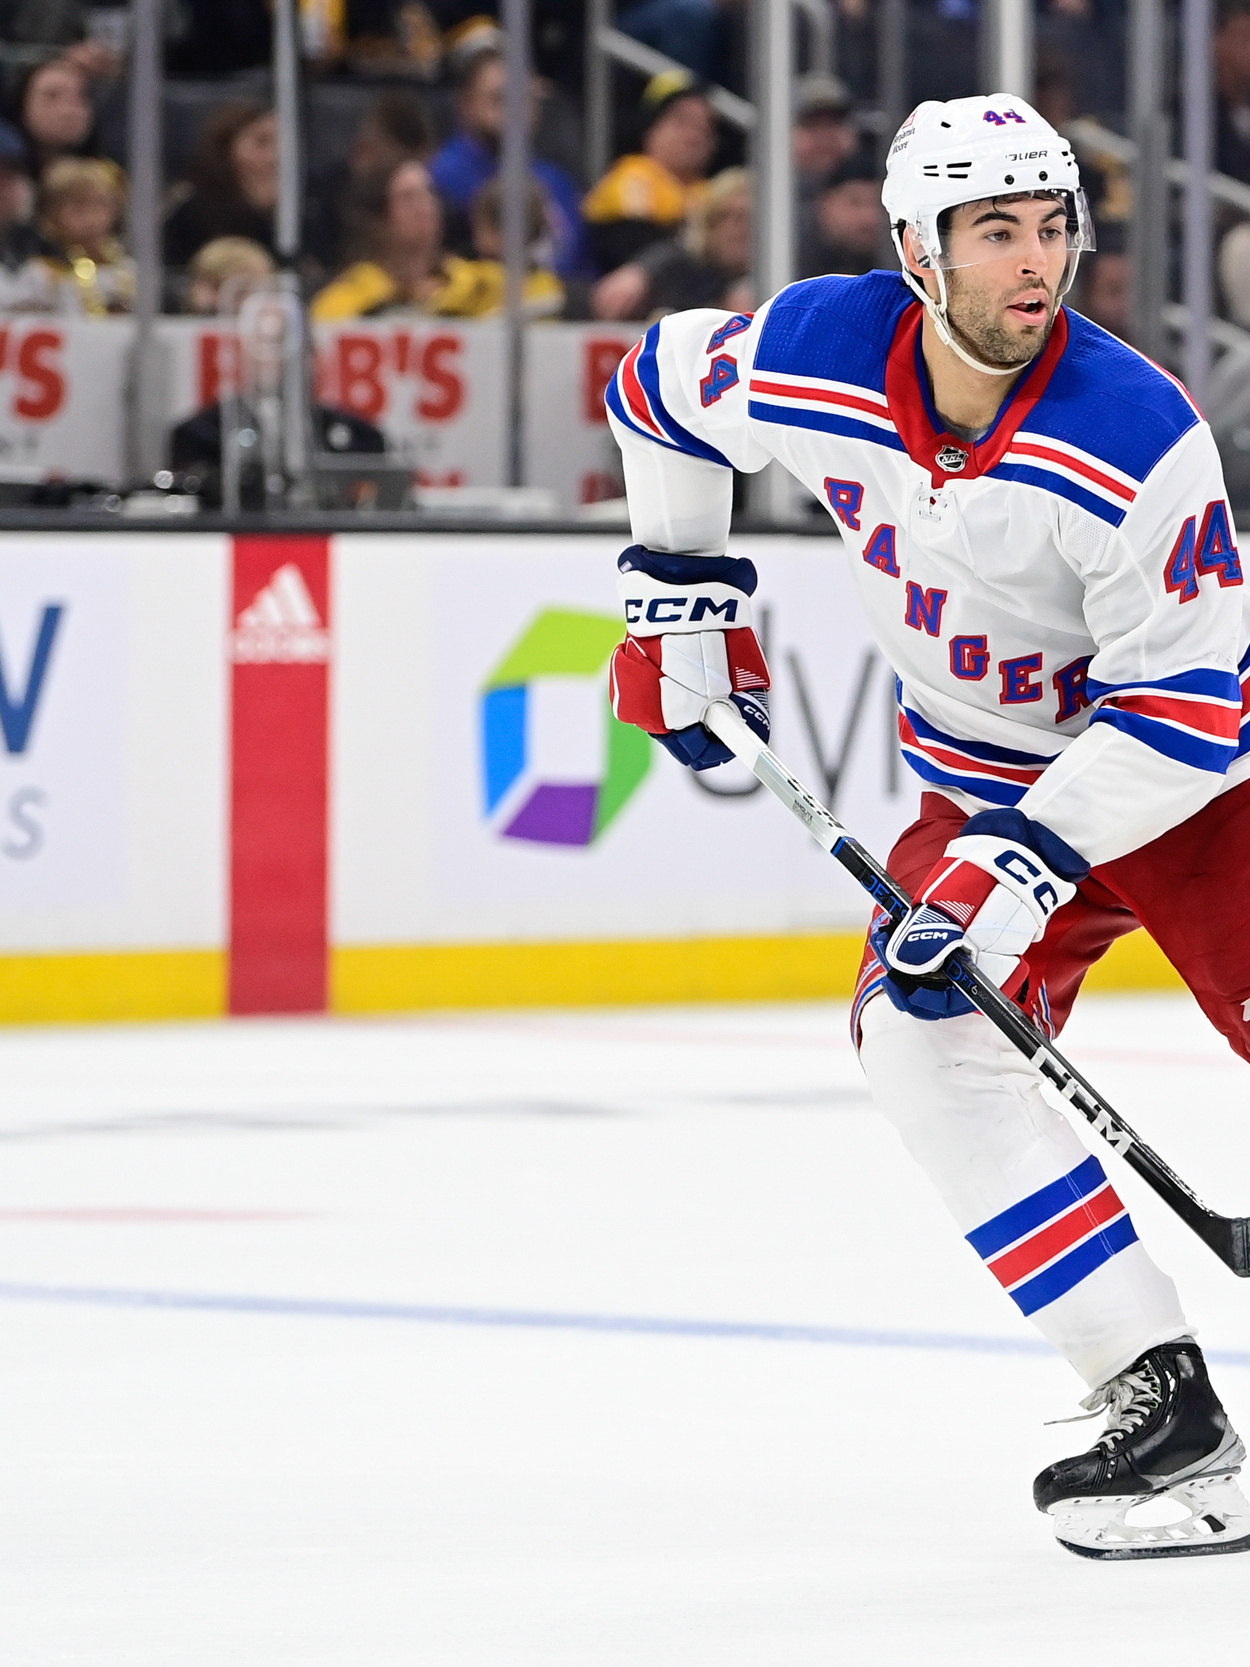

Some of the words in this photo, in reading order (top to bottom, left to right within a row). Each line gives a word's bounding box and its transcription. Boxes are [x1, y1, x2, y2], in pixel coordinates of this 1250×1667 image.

[983, 109, 1027, 126] 44
[198, 334, 467, 421] BB'S
[699, 312, 755, 408] 44
[1163, 499, 1244, 605] 44
[625, 597, 738, 623] CCM
[743, 705, 770, 731] CCM
[907, 931, 949, 942] CCM
[1030, 1046, 1135, 1157] CCM
